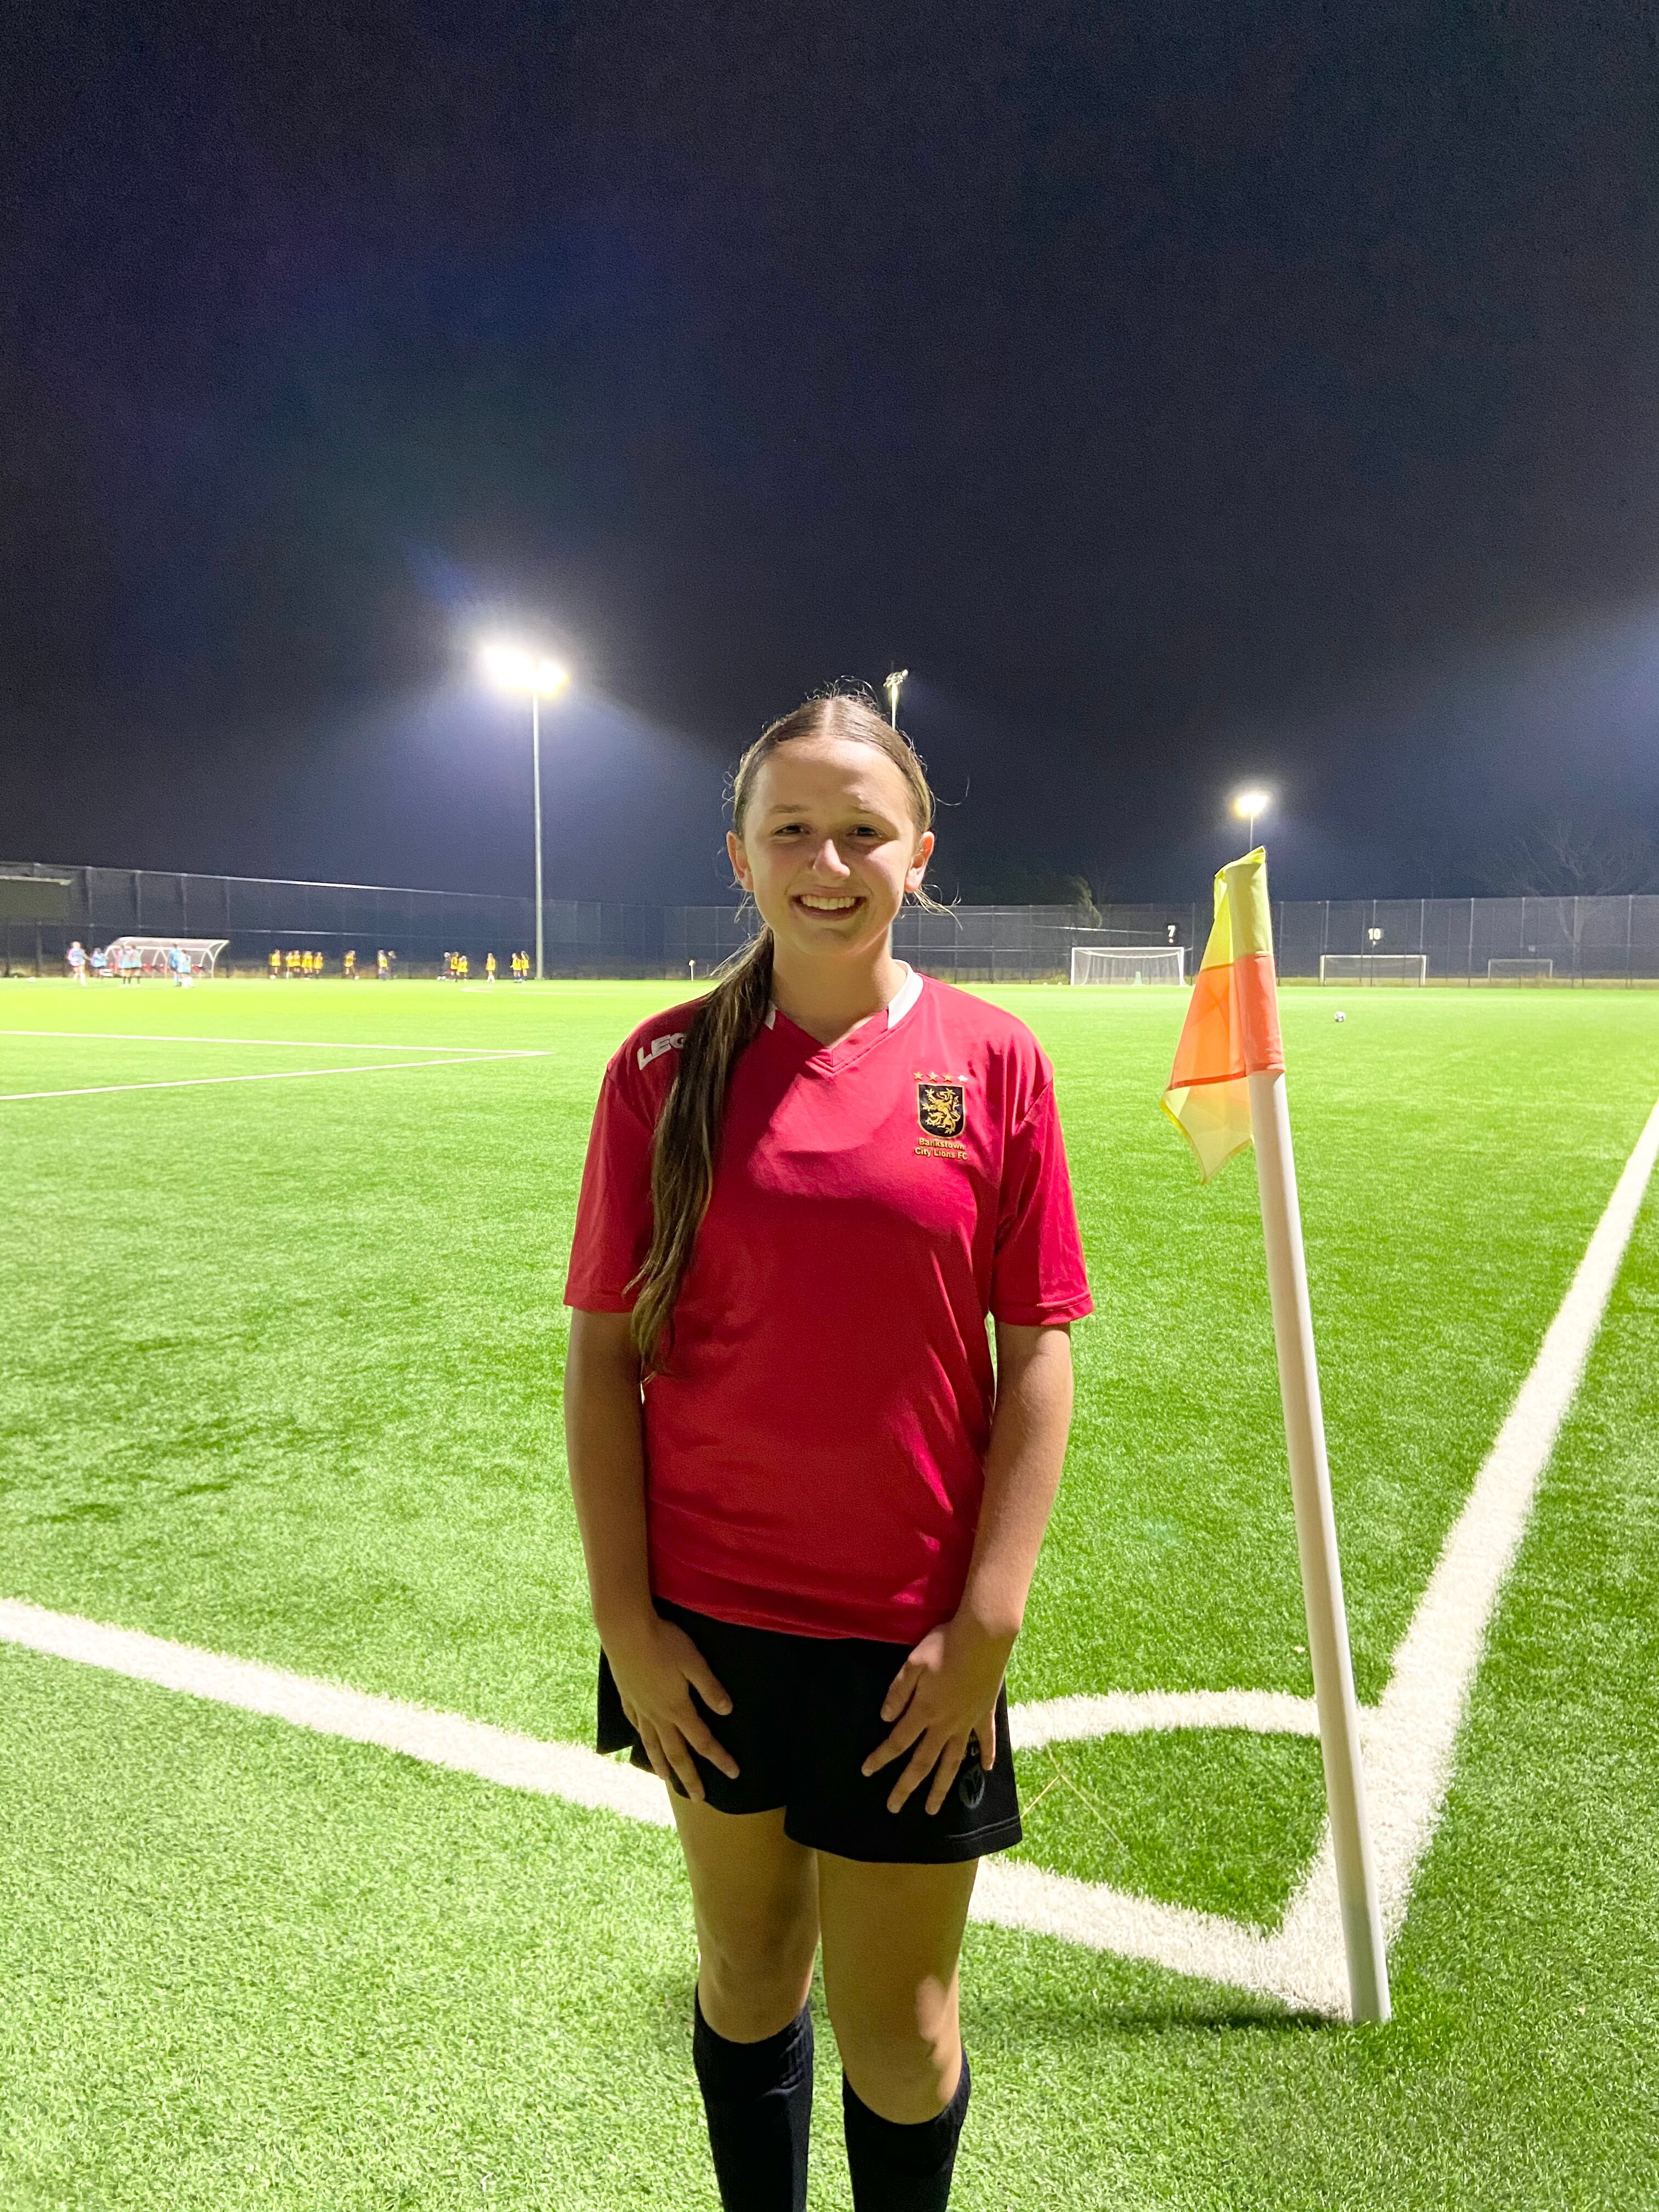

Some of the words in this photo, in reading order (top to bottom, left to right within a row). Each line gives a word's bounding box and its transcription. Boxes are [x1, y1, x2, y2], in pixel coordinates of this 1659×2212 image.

[1368, 928, 1381, 940] 10
[919, 1137, 965, 1150] Bankstown
[915, 1147, 931, 1157] City
[934, 1148, 956, 1158] Lions
[957, 1151, 968, 1160] FC
